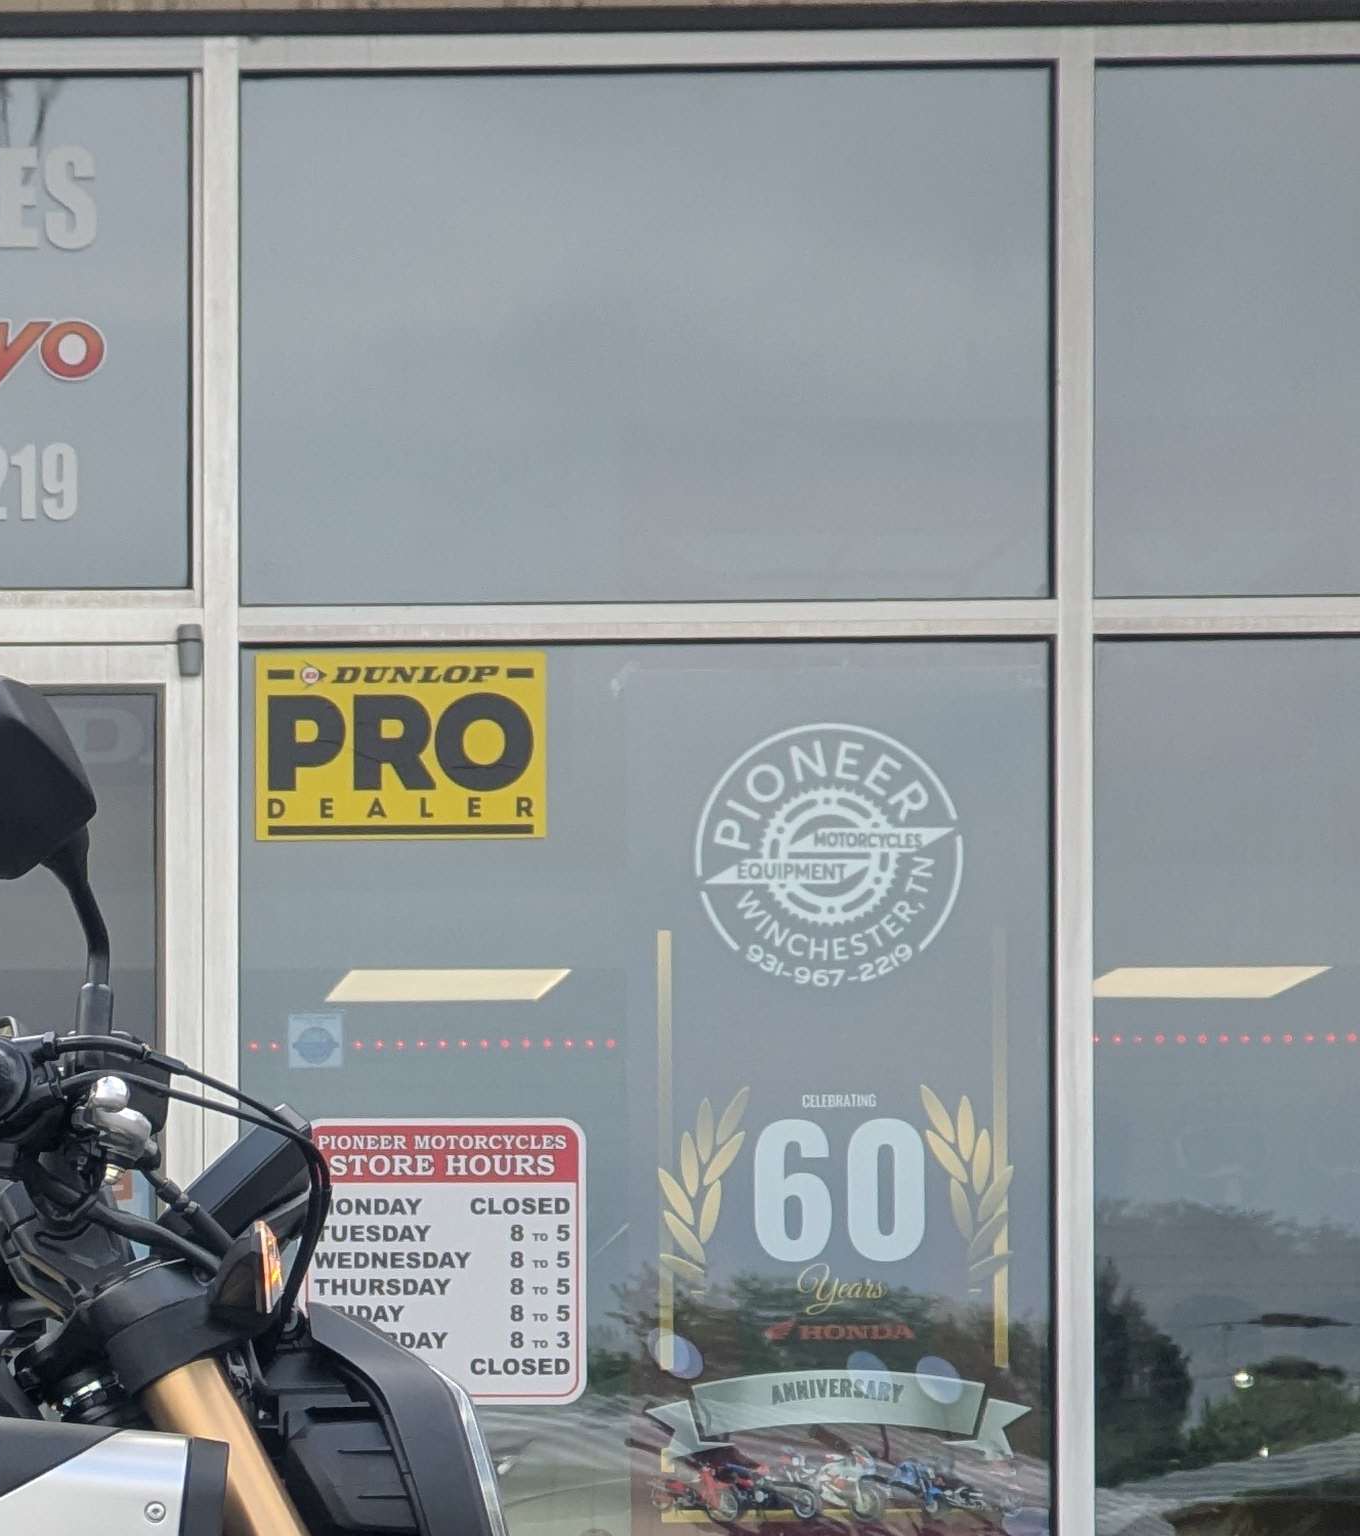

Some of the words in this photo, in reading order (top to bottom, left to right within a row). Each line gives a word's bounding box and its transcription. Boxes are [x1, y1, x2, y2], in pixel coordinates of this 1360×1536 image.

[332, 665, 499, 684] DUNLOP
[267, 692, 534, 792] PRO
[713, 740, 929, 850] PIONEER
[267, 797, 534, 819] DEALER
[813, 832, 924, 848] MOTORCYCLES
[736, 863, 848, 880] EQUIPMENT
[905, 855, 935, 893] TN
[746, 943, 913, 987] 931-967-2219
[802, 1094, 877, 1108] CELEBRATING
[318, 1135, 406, 1150] PIONEER
[414, 1134, 568, 1150] MOTORCYCLES
[330, 1154, 435, 1177] STORE
[445, 1154, 556, 1176] HOURS
[754, 1118, 926, 1263] 60
[329, 1198, 422, 1215] ONDAY
[470, 1197, 571, 1215] CLOSED
[510, 1224, 524, 1242] 8
[532, 1232, 549, 1242] TO
[556, 1224, 571, 1242] 5
[315, 1251, 471, 1269] WEDNESDAY
[510, 1251, 524, 1269] 8
[532, 1259, 549, 1269] TO
[556, 1251, 571, 1269] 5
[314, 1278, 451, 1296] THURSDAY
[510, 1278, 524, 1295] 8
[532, 1286, 549, 1296] TO
[556, 1278, 571, 1295] 5
[797, 1262, 884, 1316] Years
[510, 1305, 524, 1322] 8
[532, 1313, 549, 1322] TO
[556, 1305, 571, 1322] 5
[510, 1331, 524, 1349] 8
[532, 1339, 549, 1349] TO
[556, 1331, 571, 1349] 3
[799, 1323, 915, 1340] HONDA
[470, 1358, 571, 1375] CLOSED
[771, 1377, 904, 1405] ANNIVERSARY
